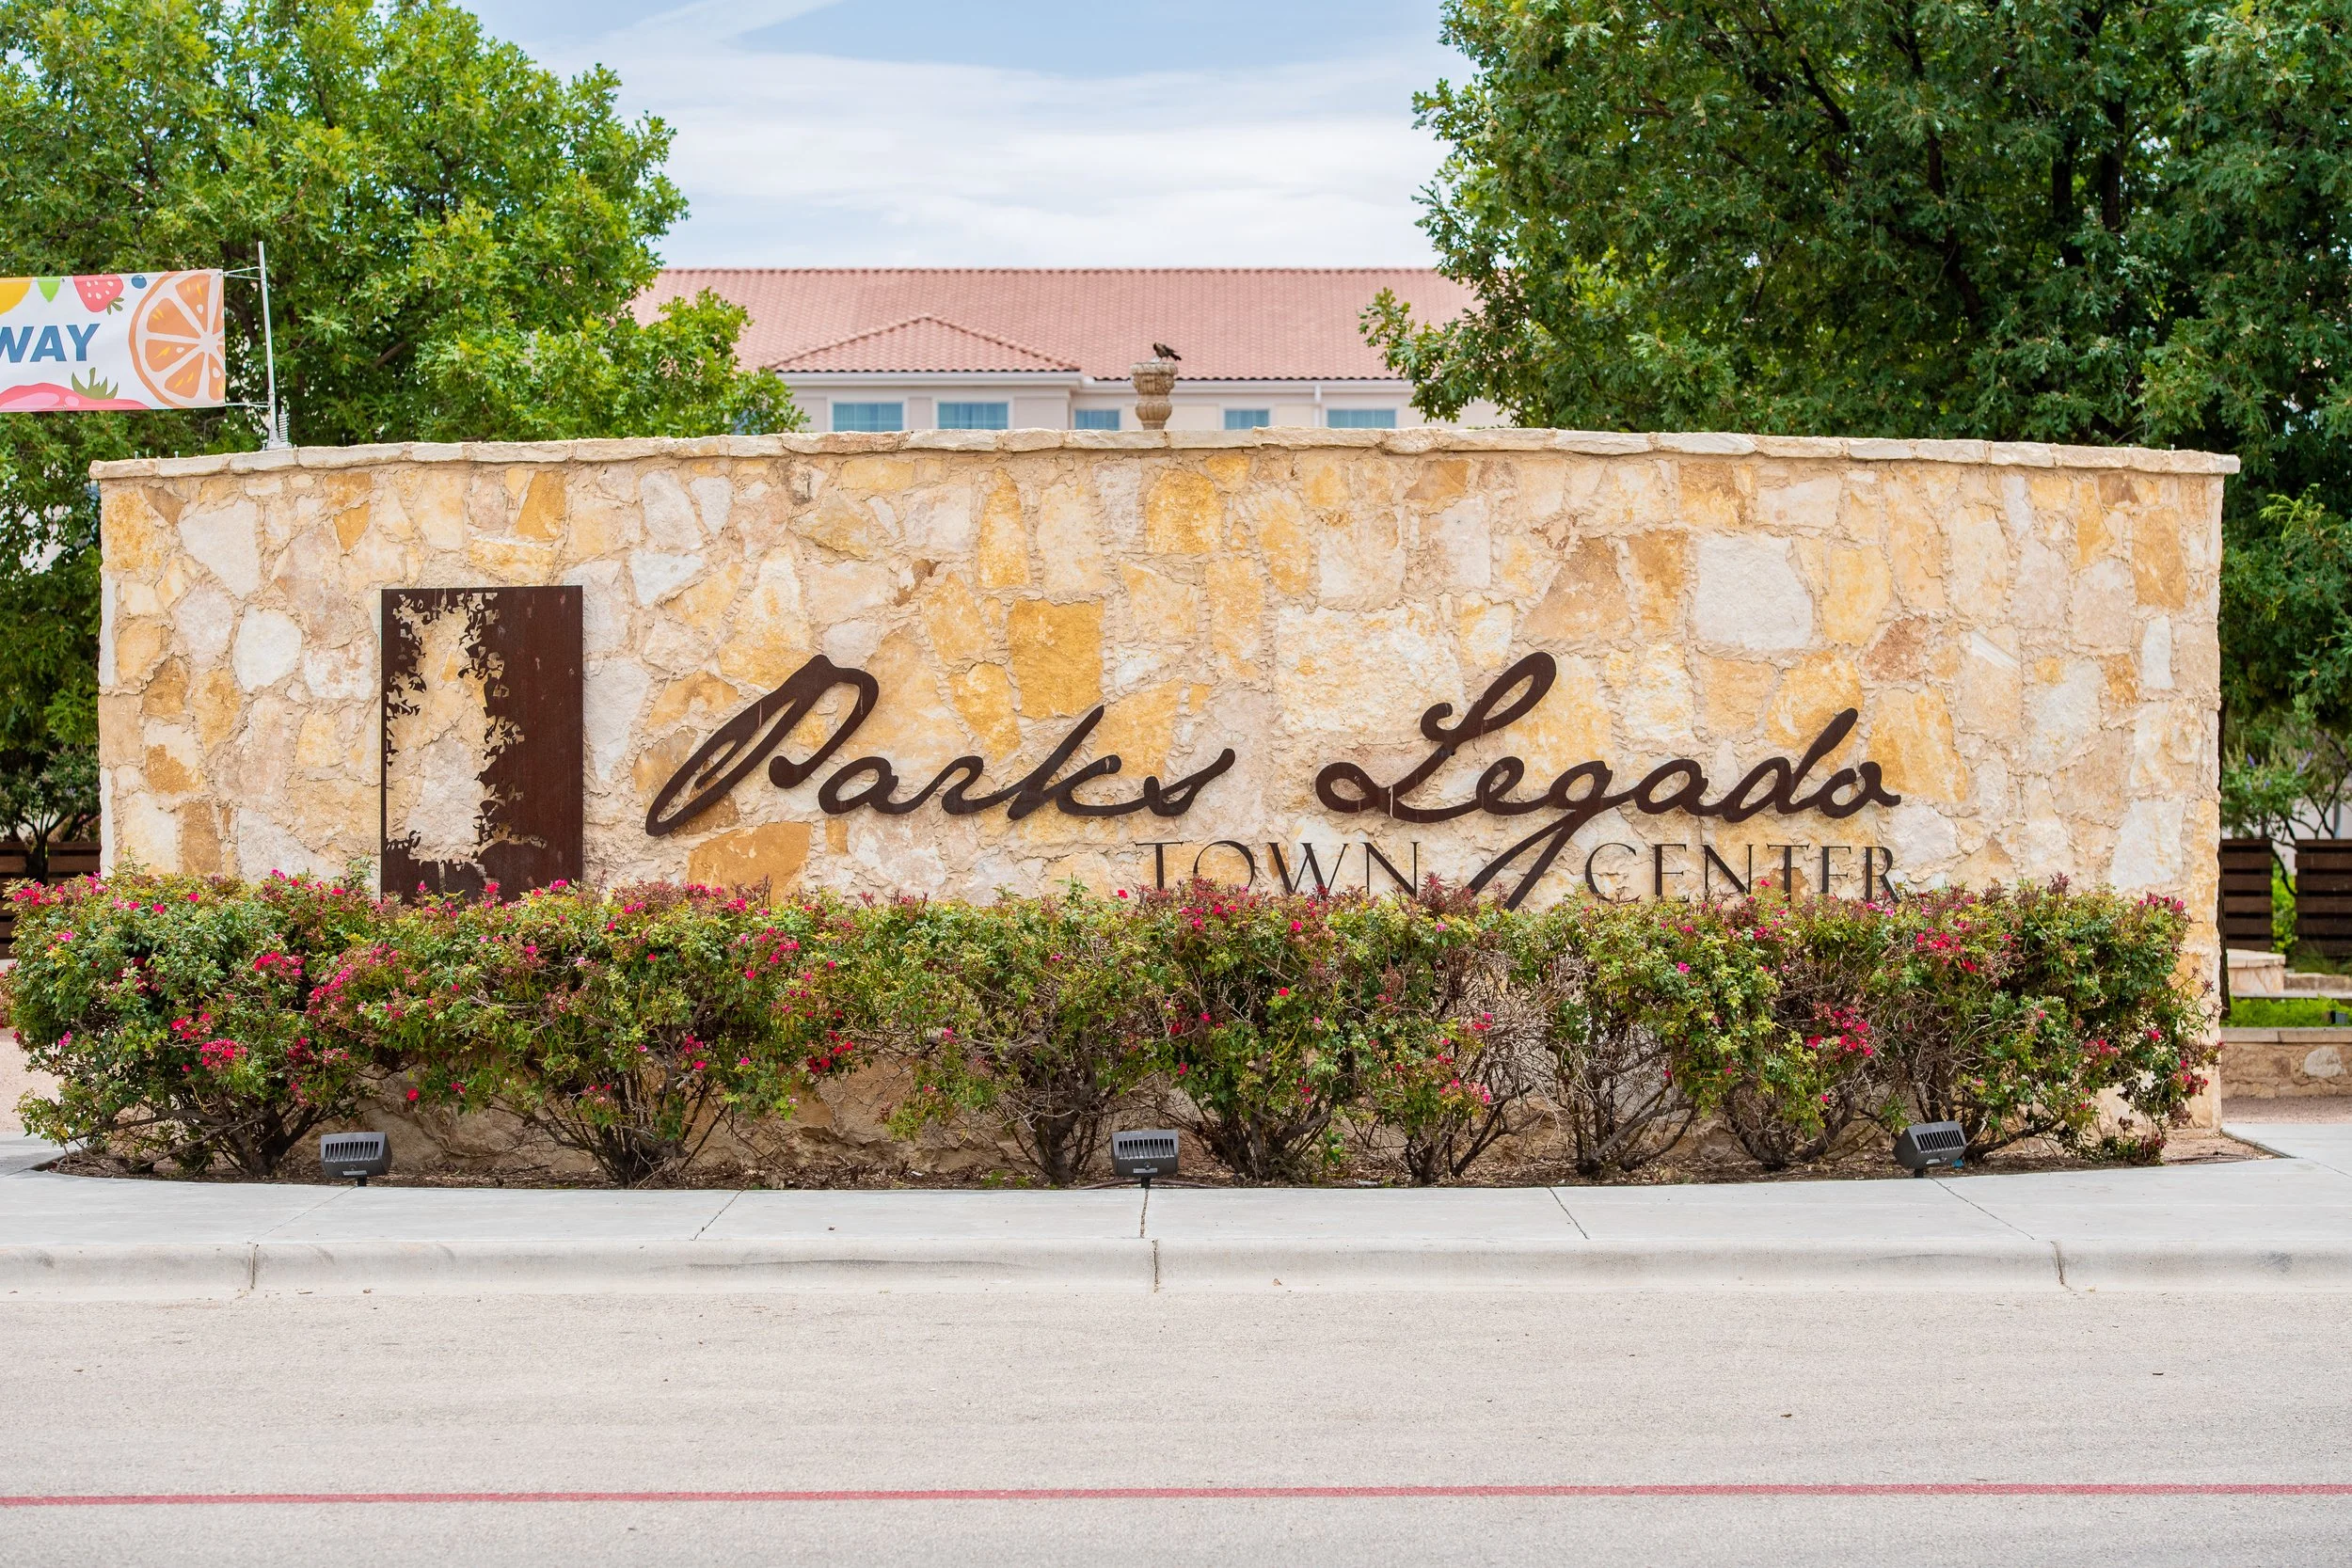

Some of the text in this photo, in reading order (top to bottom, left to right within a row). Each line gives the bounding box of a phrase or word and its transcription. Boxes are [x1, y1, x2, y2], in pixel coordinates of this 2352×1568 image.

[645, 652, 1901, 911] Parks Legado
[1135, 840, 1901, 903] TOWN CENTER
